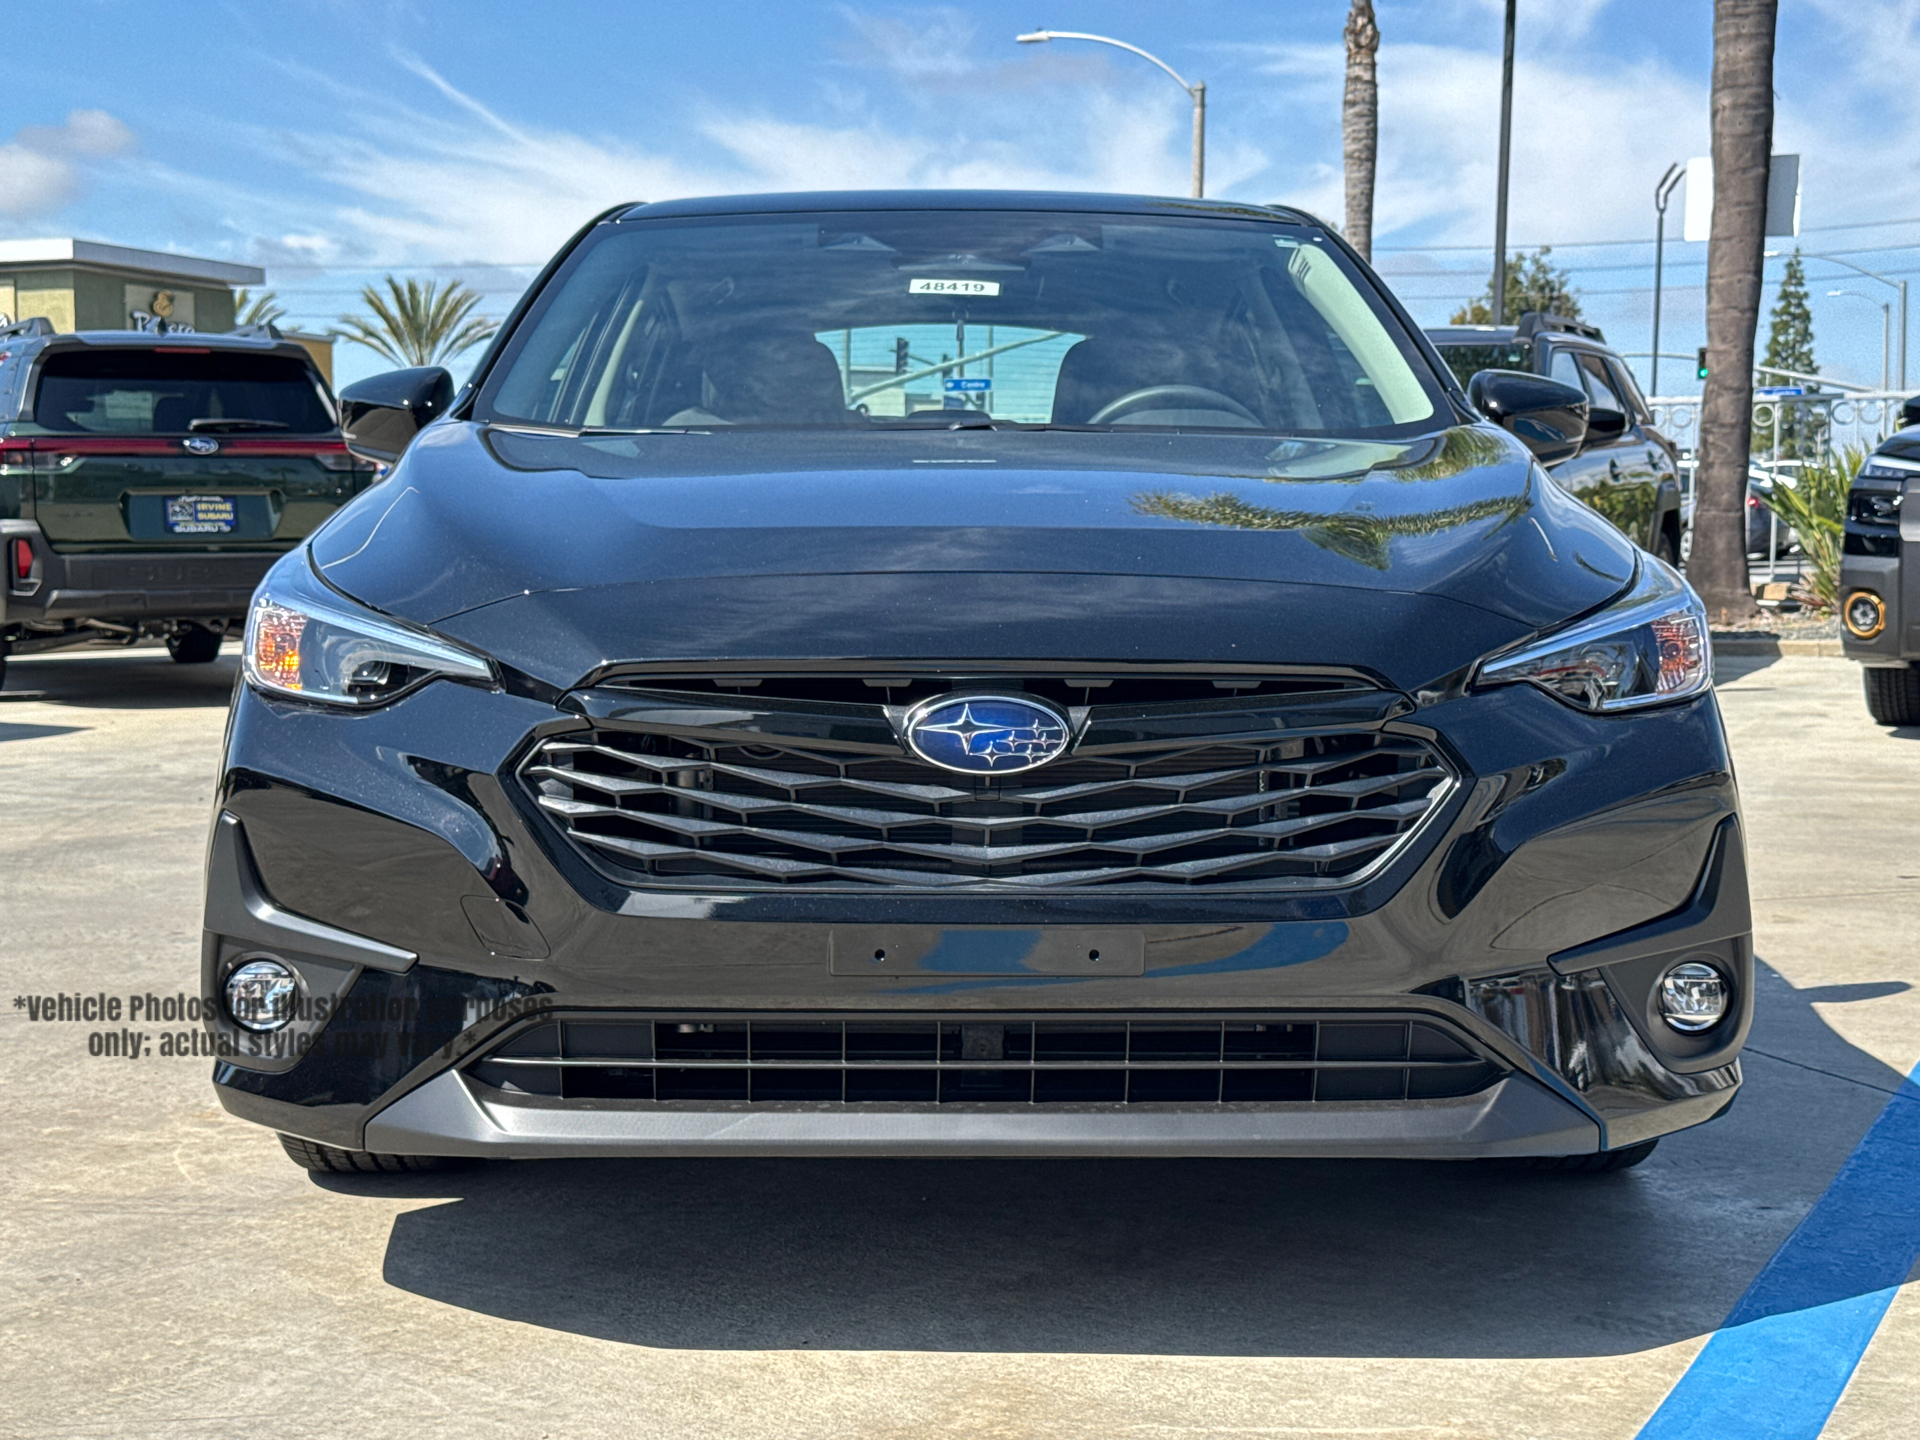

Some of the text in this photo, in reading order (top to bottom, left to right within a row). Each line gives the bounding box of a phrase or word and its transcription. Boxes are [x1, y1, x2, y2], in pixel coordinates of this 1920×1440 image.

[919, 281, 986, 293] 48419
[196, 502, 233, 511] IRVINE
[197, 512, 234, 520] SUBARU
[174, 525, 219, 533] SUBARU
